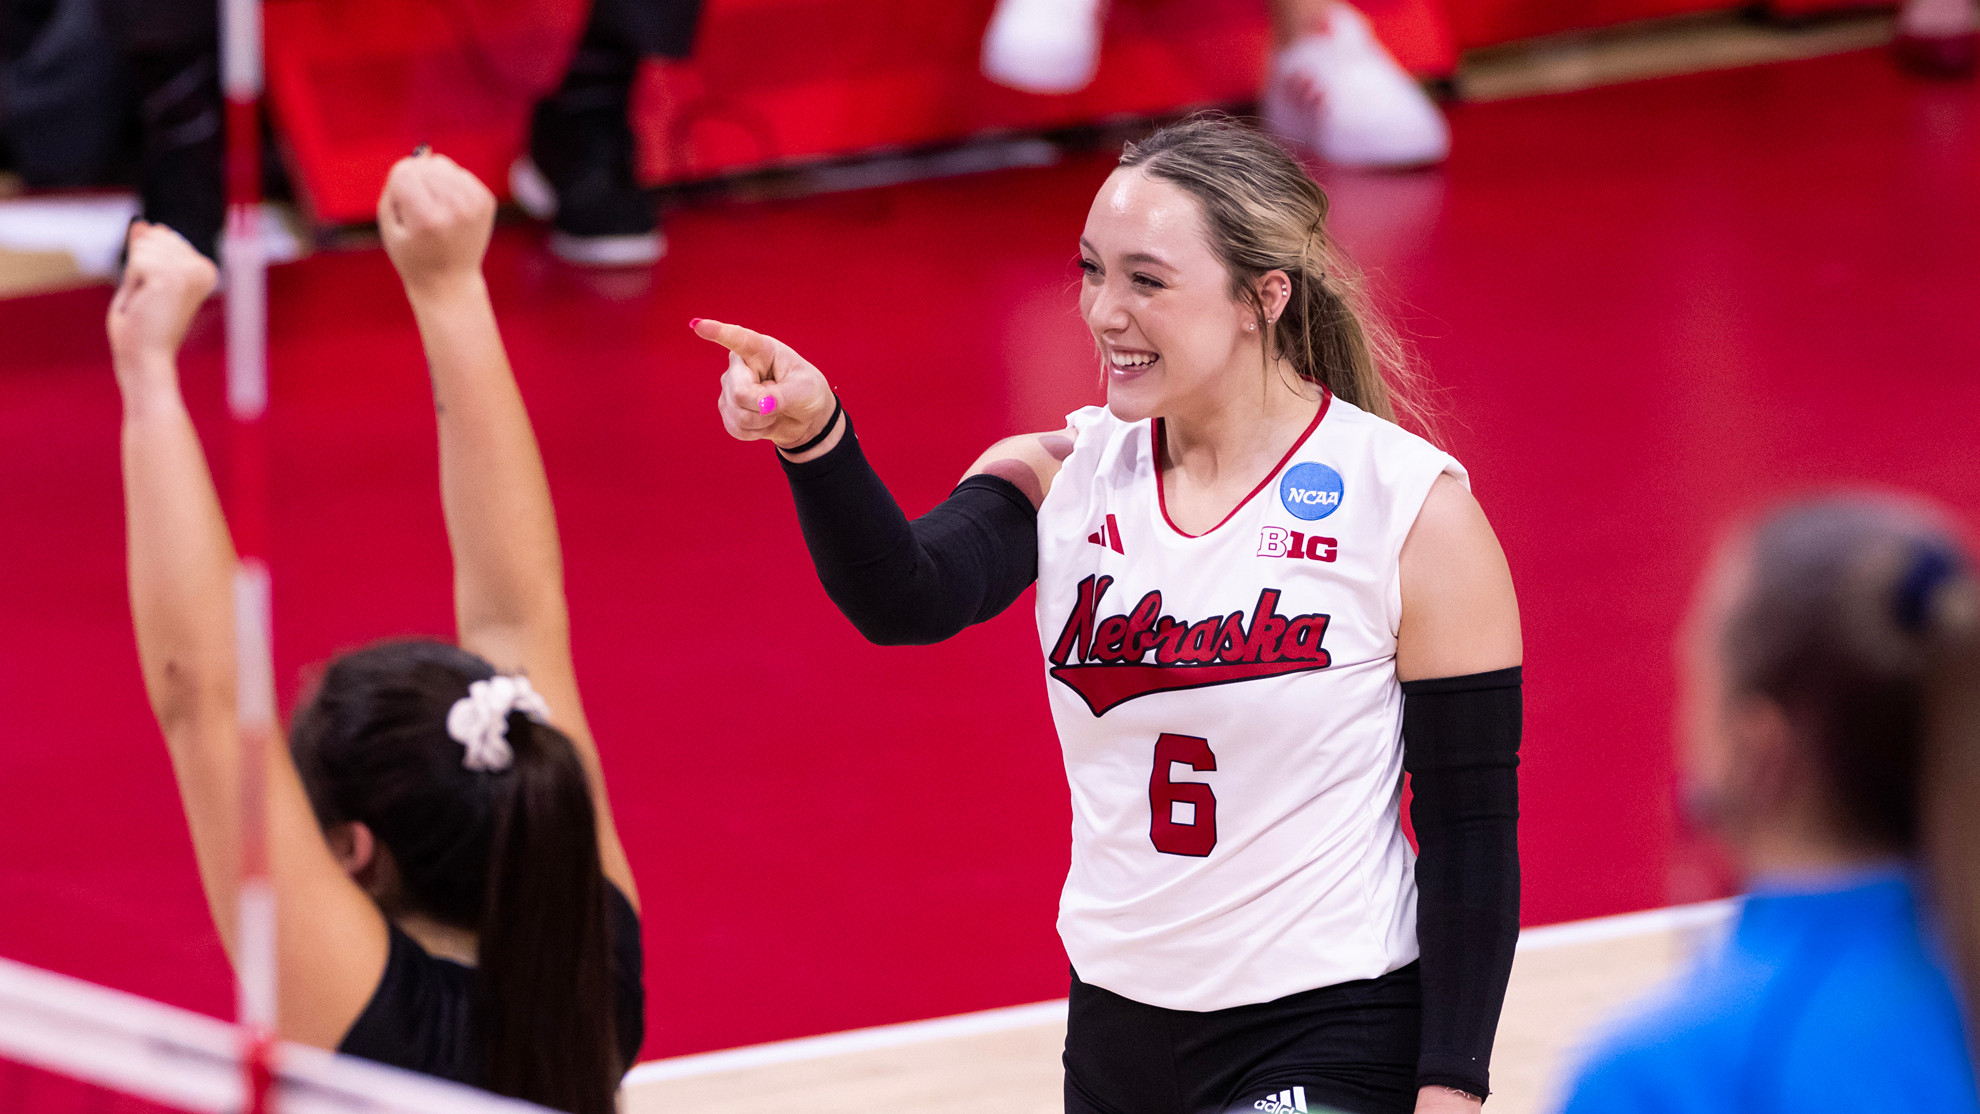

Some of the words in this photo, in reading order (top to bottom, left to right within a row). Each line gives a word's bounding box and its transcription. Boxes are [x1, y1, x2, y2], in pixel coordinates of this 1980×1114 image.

[1288, 487, 1339, 505] NCAA
[1049, 574, 1331, 667] Nebraska
[1149, 732, 1217, 857] 6
